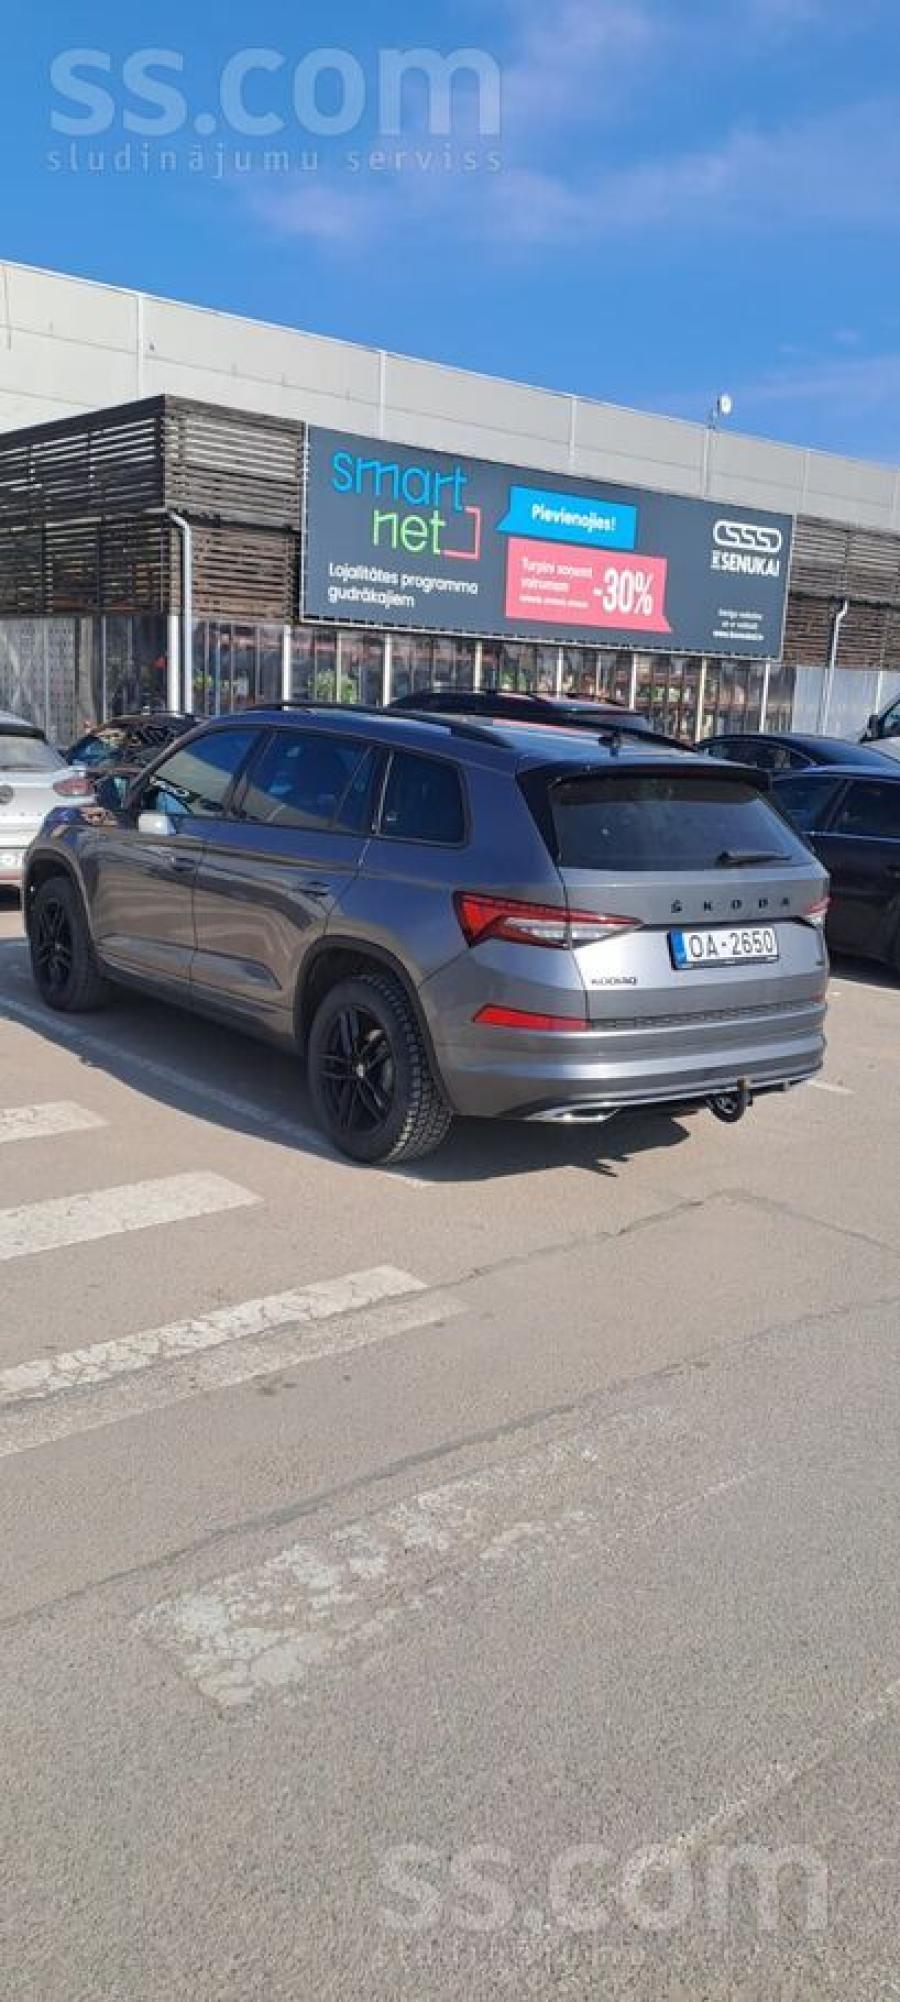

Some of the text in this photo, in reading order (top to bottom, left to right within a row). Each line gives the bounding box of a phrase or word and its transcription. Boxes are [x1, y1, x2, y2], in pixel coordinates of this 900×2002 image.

[331, 451, 468, 512] smart
[372, 509, 447, 555] net
[400, 573, 479, 596] programma
[592, 566, 655, 616] -30%
[688, 930, 774, 958] OA-2650
